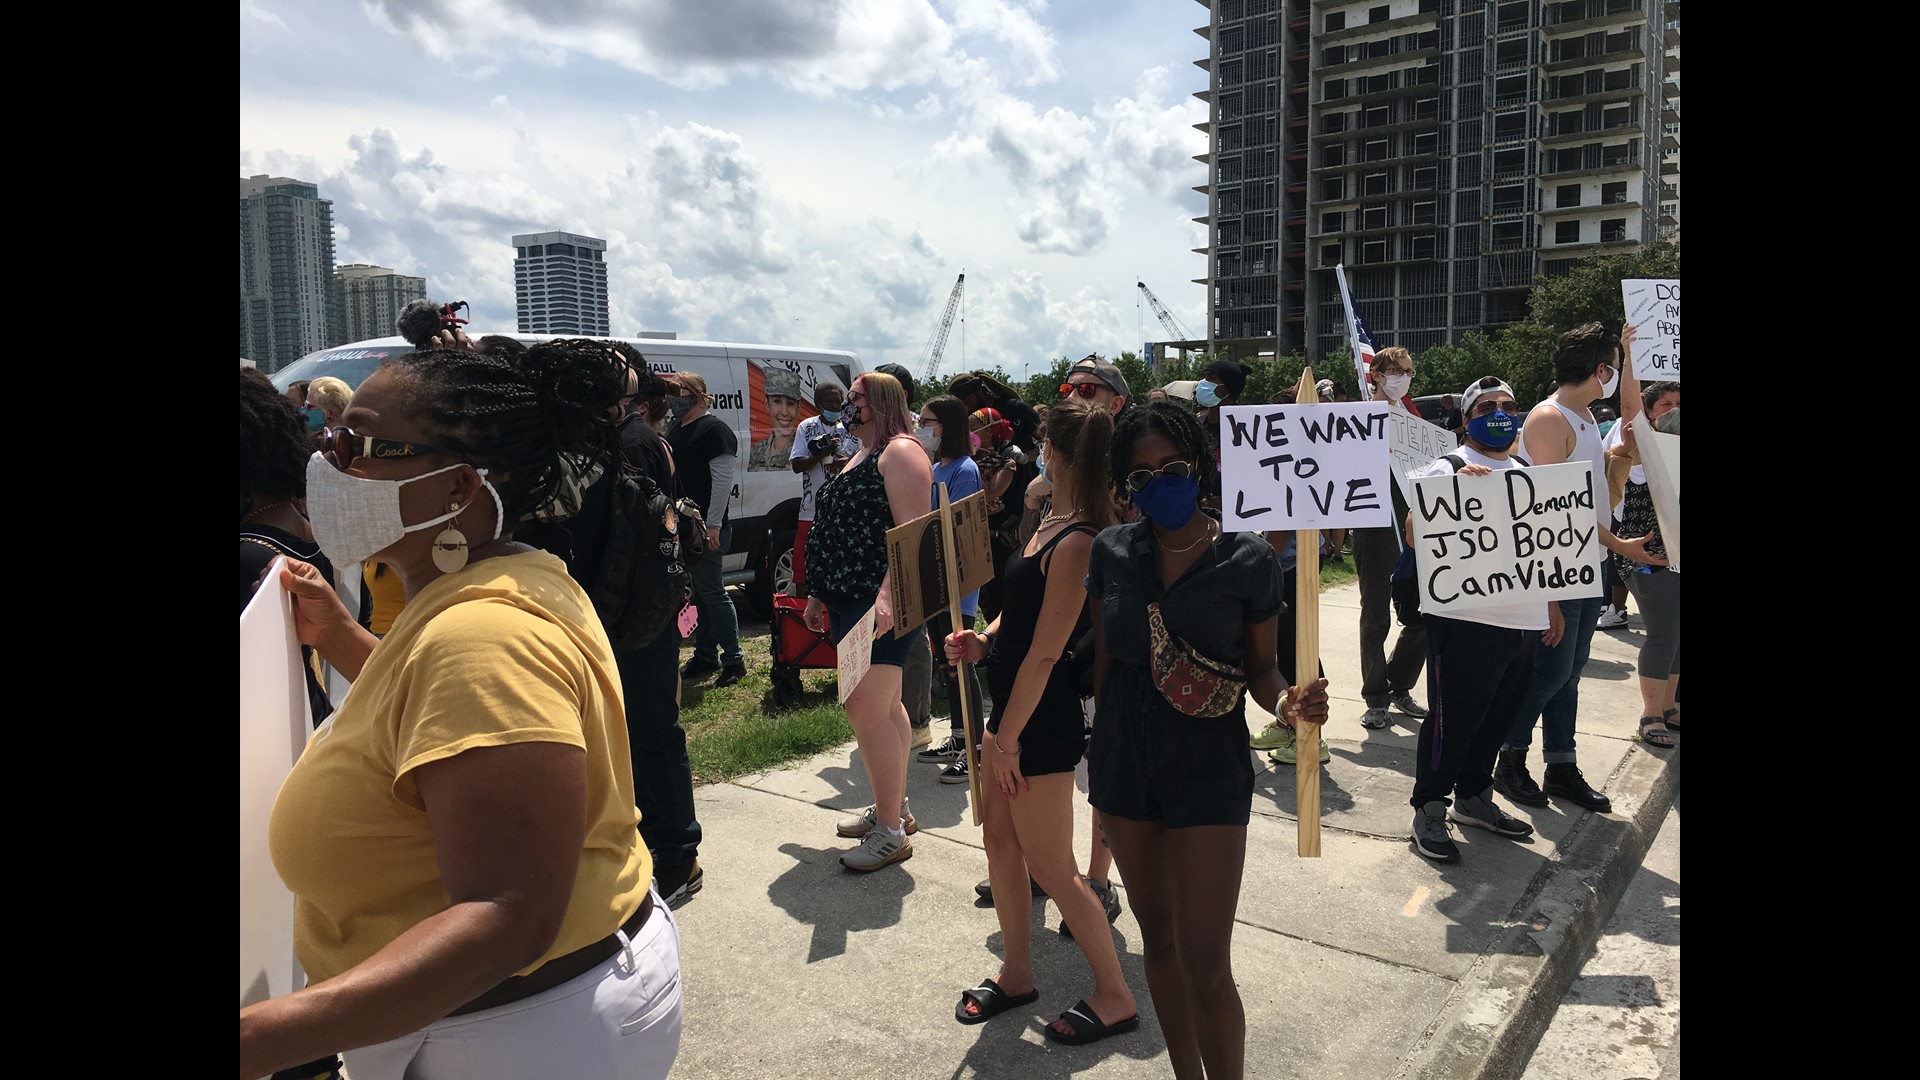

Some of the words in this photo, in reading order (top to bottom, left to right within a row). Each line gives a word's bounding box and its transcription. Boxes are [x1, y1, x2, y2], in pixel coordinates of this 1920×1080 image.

[1652, 353, 1669, 370] OF
[1226, 411, 1290, 450] WE
[1299, 412, 1389, 444] WANT
[1390, 411, 1449, 459] TEAR
[375, 443, 415, 457] Coach
[1258, 453, 1320, 482] TO
[1235, 478, 1381, 520] LIVE
[1415, 475, 1485, 523] We
[1504, 469, 1595, 521] Demand
[932, 523, 941, 561] Board
[1422, 525, 1499, 560] JSO
[936, 562, 946, 605] Display
